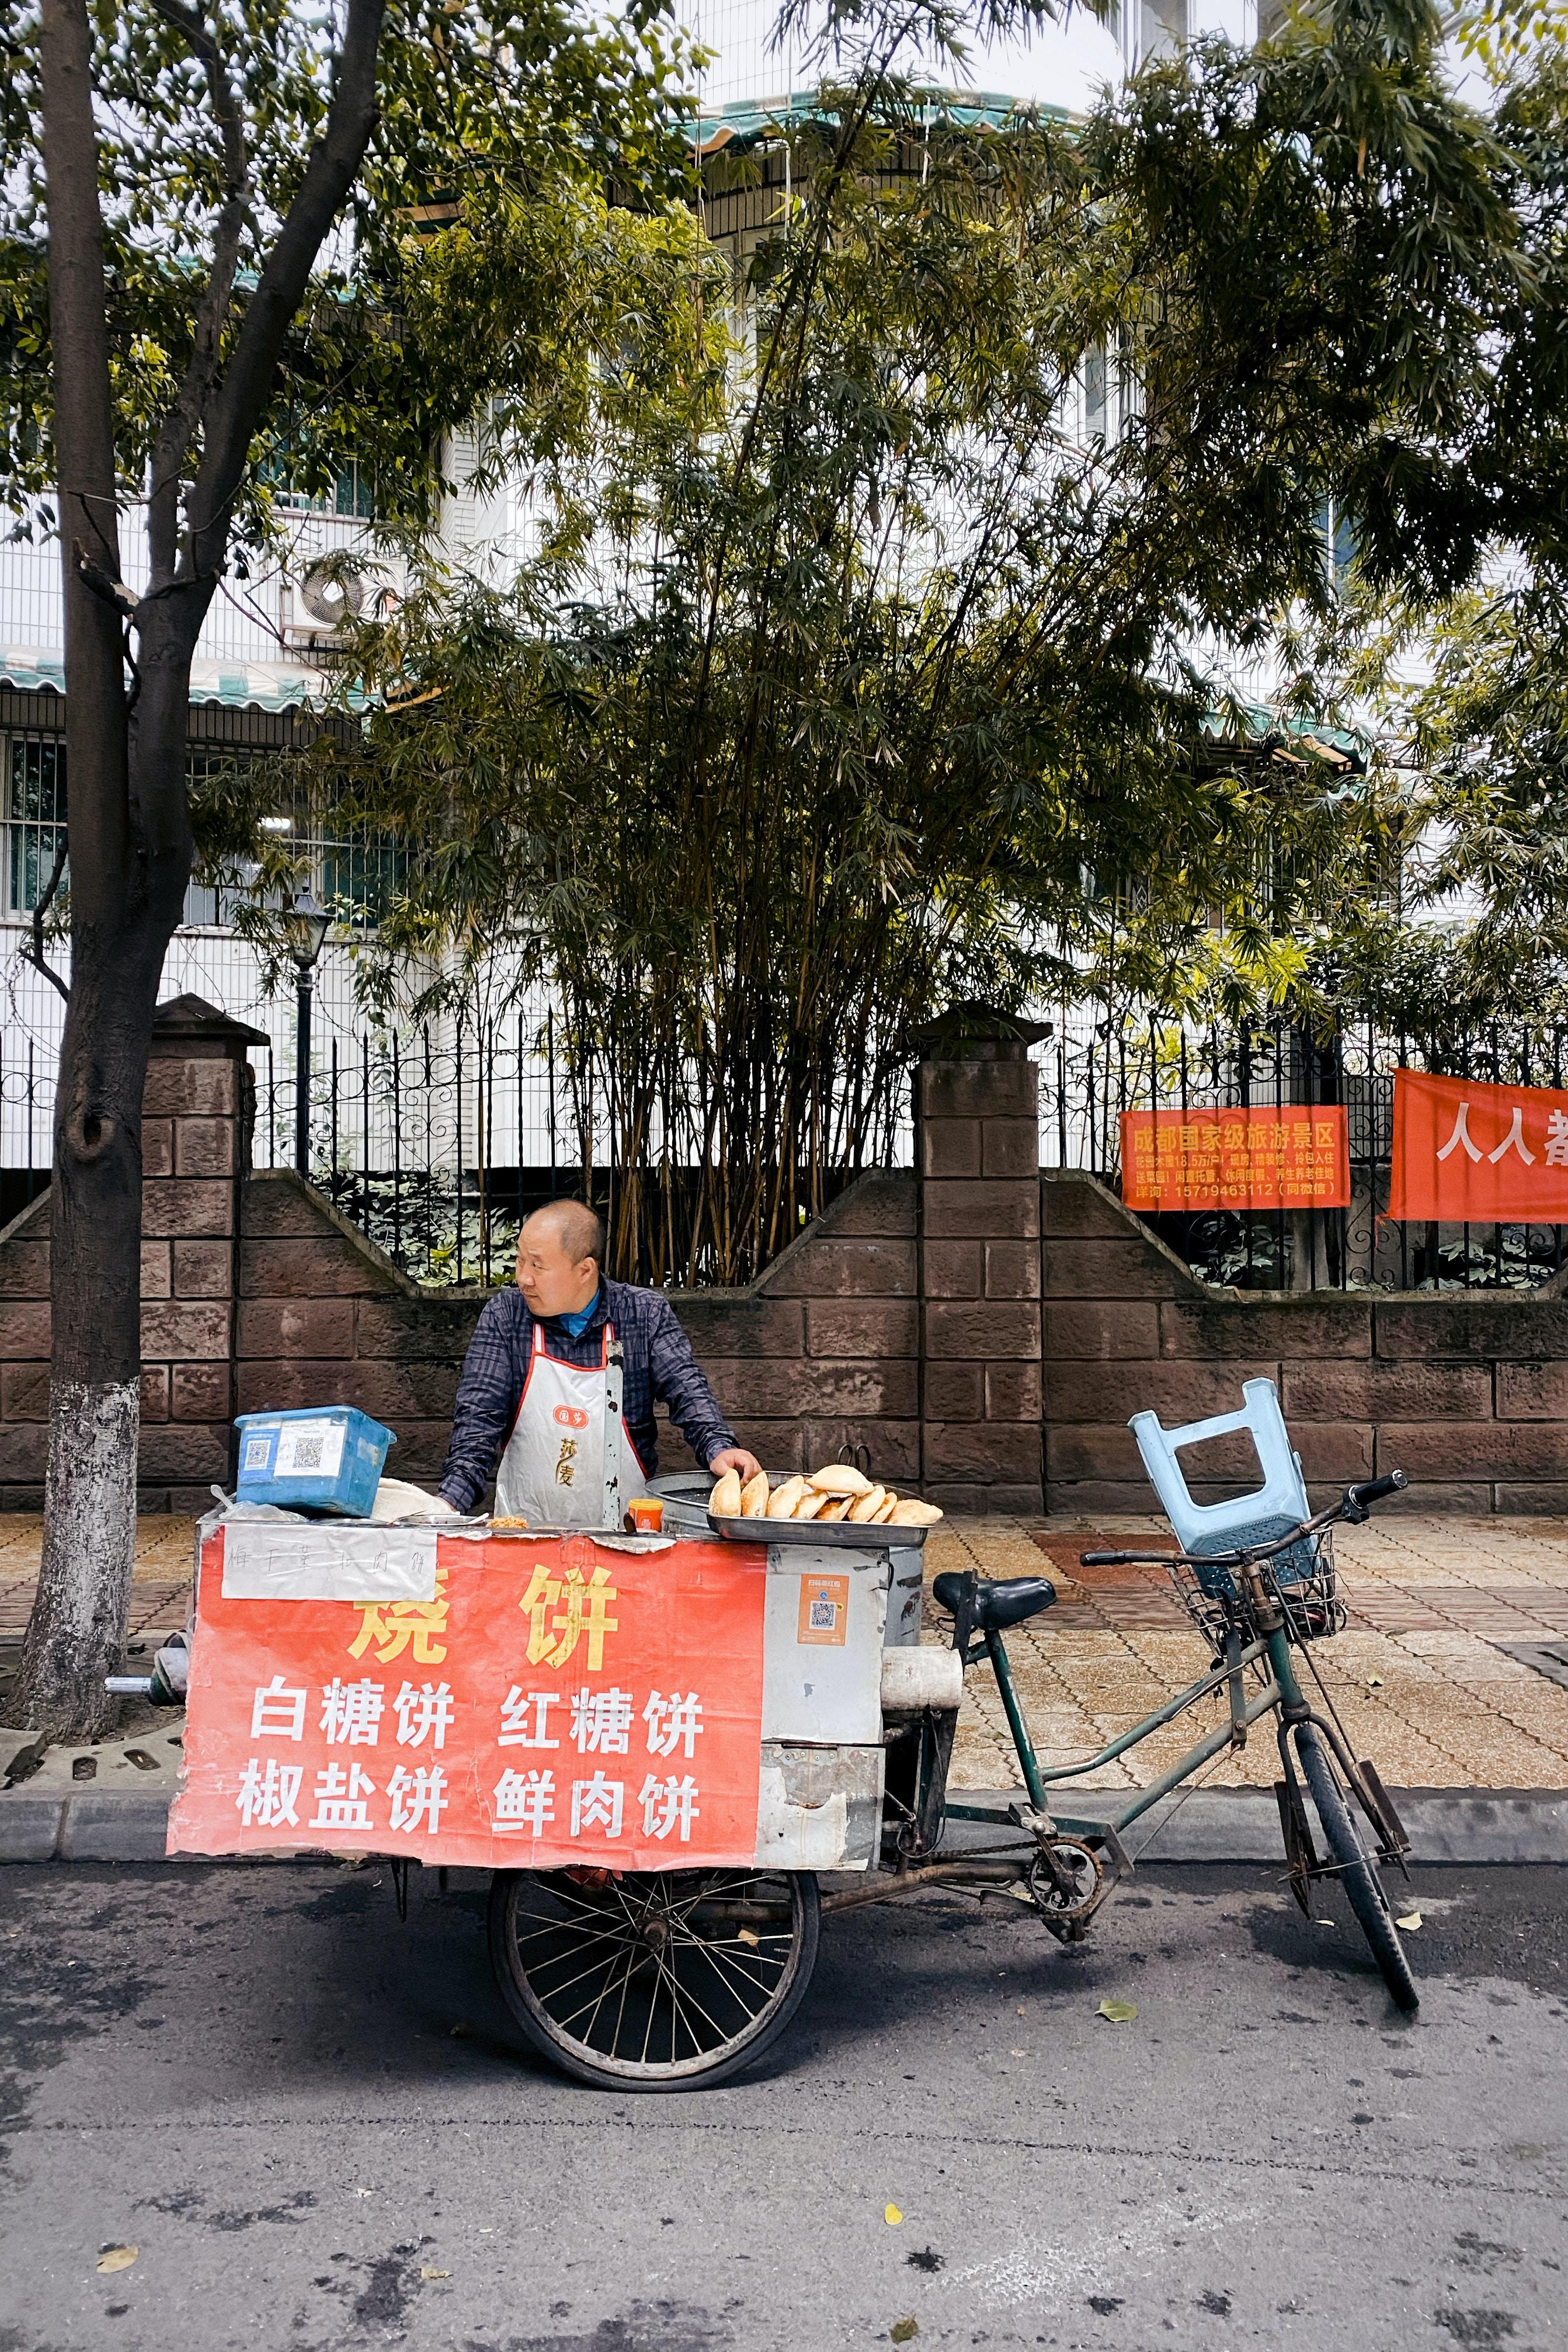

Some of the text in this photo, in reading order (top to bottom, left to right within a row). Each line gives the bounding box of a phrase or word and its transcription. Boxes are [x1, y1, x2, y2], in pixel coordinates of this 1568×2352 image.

[1134, 1122, 1335, 1152] 成都国家级旅游景区
[347, 1564, 619, 1671] 烧饼
[250, 1674, 704, 1759] 白糖饼 红糖饼
[235, 1757, 700, 1842] 椒盐饼 鲜肉饼
